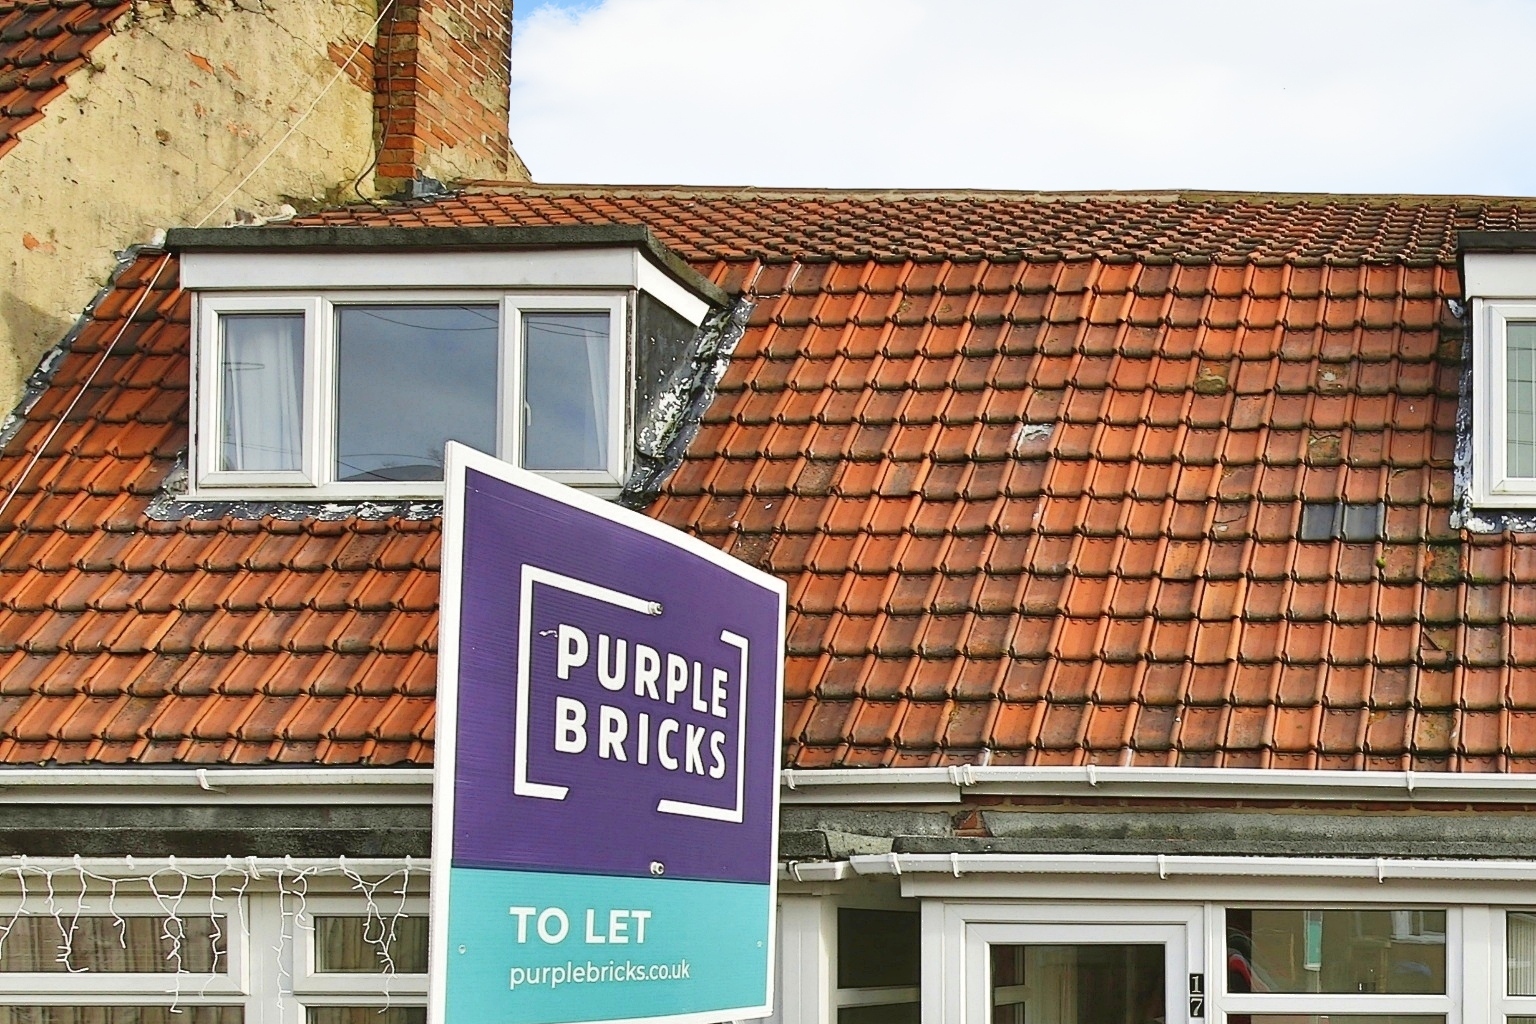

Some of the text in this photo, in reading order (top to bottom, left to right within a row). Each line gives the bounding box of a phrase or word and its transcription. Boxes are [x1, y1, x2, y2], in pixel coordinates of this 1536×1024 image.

[556, 623, 729, 719] PURPLE
[554, 696, 726, 780] BRICKS
[509, 906, 652, 944] TO LET
[509, 959, 690, 990] purplebricks.co.uk
[1190, 975, 1203, 1016] 17
